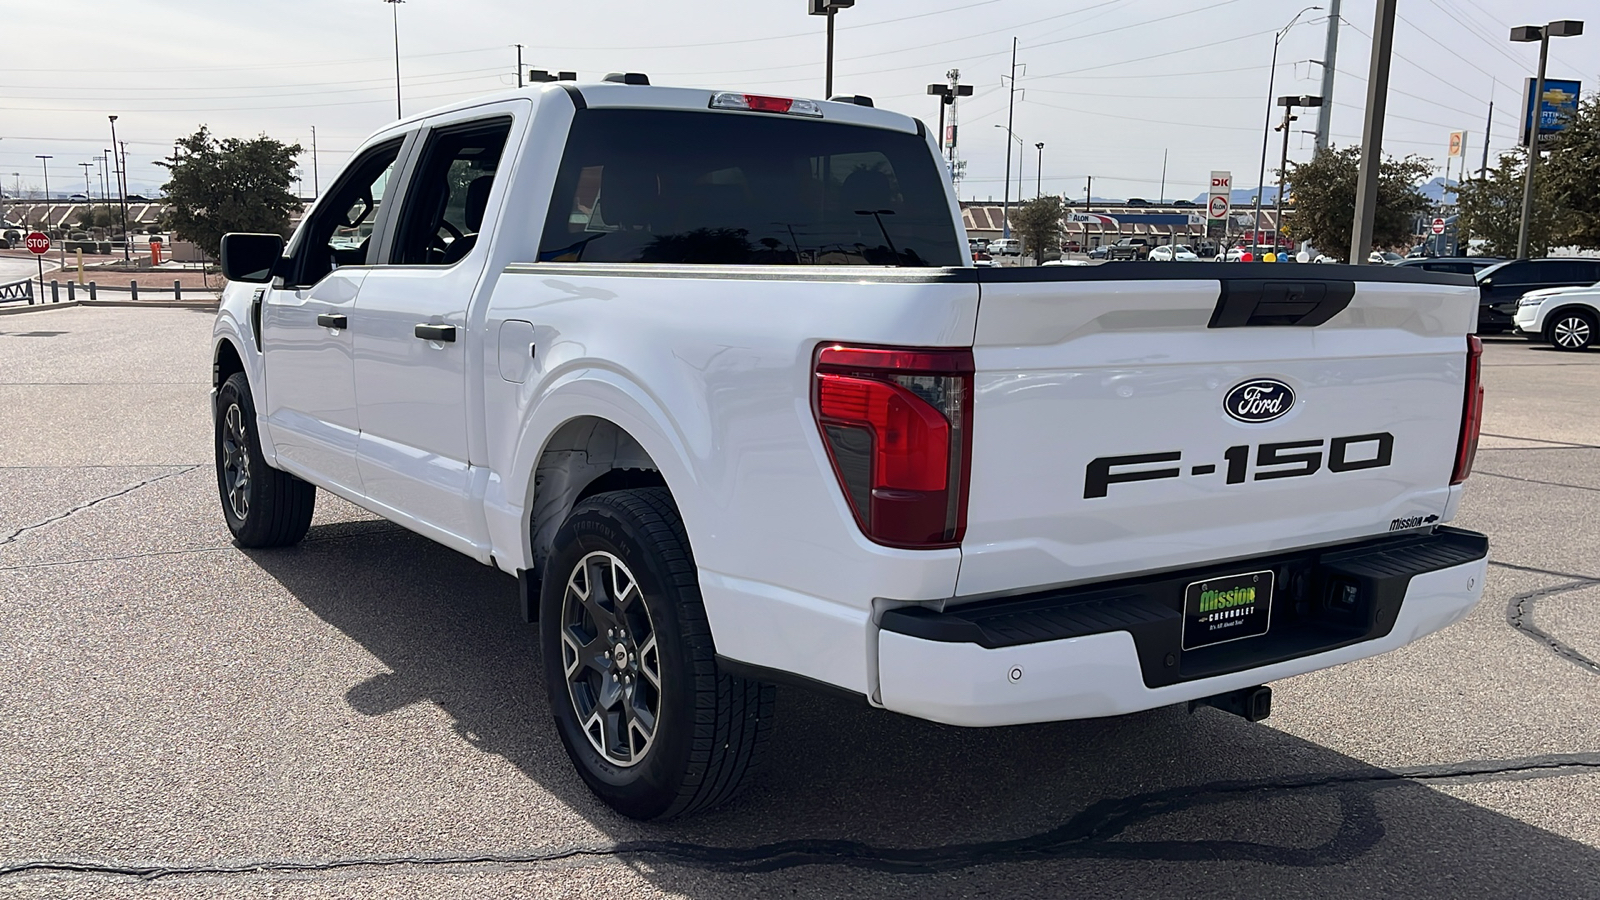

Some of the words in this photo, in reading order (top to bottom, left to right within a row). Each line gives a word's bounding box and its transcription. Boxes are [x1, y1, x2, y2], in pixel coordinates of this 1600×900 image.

[1212, 178, 1229, 187] DK
[1073, 214, 1089, 222] ALON
[27, 239, 48, 248] STOP
[1237, 386, 1284, 415] Ford
[1083, 431, 1394, 499] F-150
[1209, 606, 1254, 622] CHEVROLET
